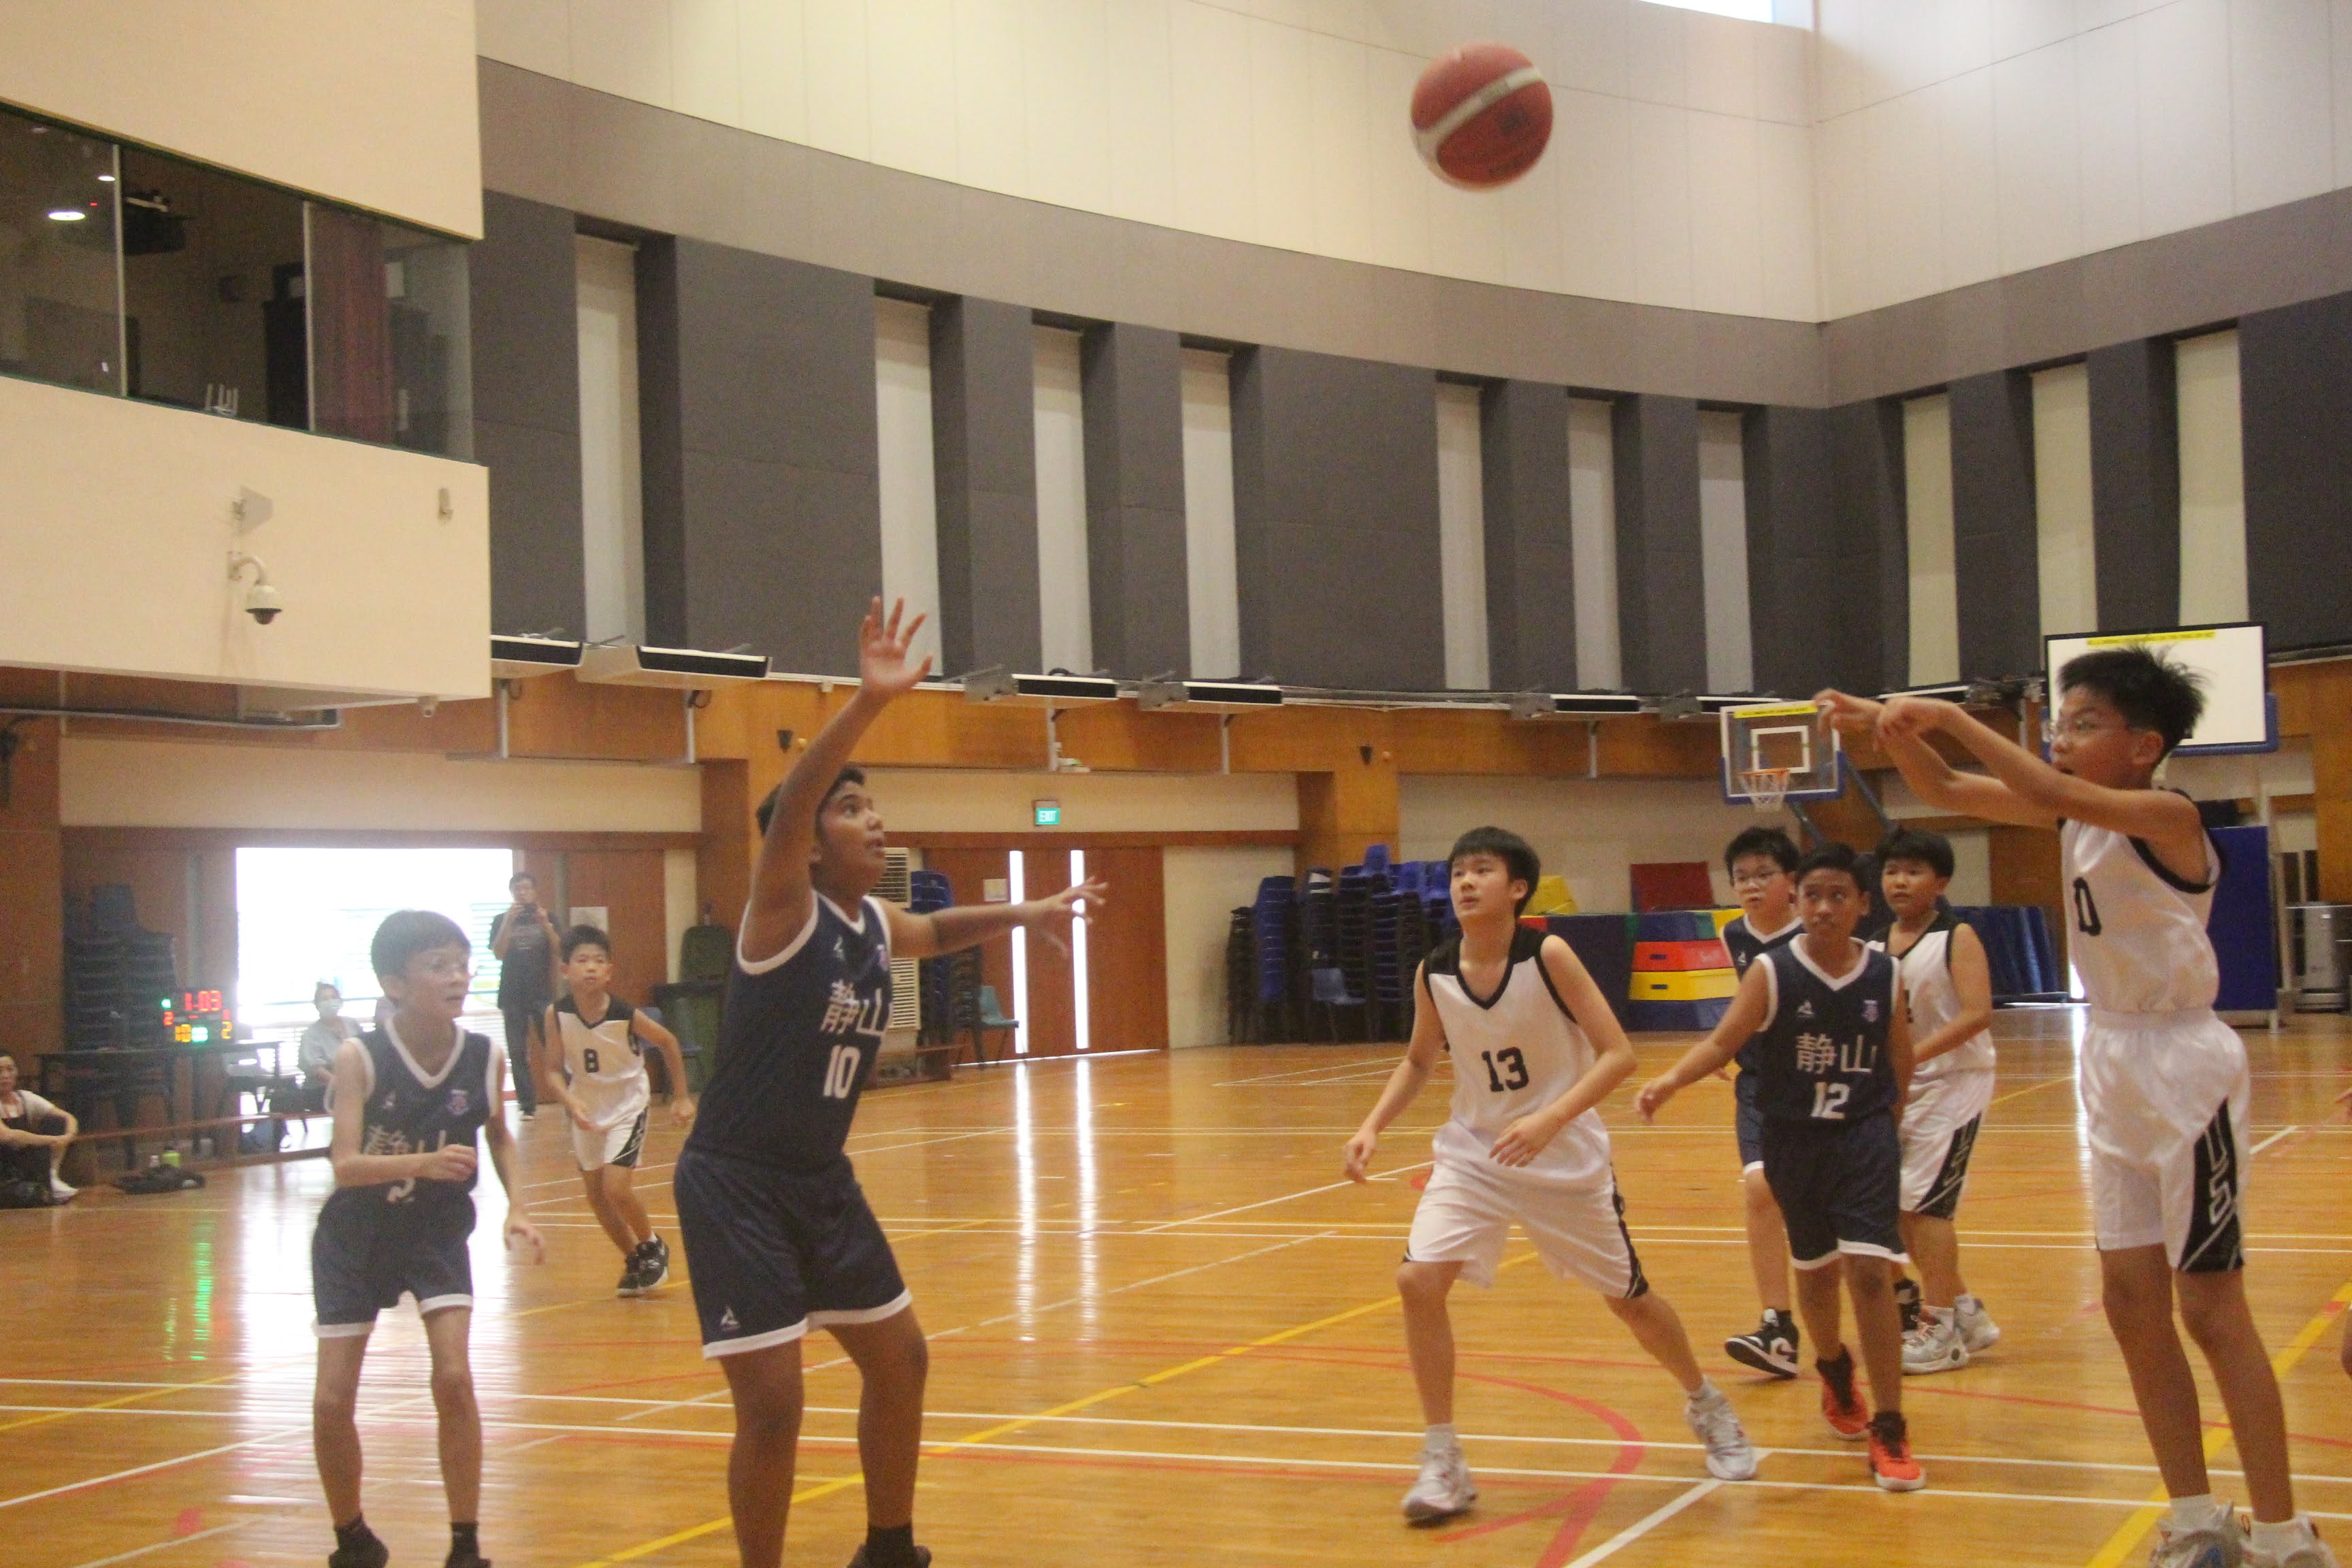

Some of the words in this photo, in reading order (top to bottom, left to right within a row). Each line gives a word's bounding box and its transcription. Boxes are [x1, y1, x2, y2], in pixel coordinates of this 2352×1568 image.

[221, 1021, 232, 1040] 2
[823, 1044, 862, 1099] 10
[1482, 1047, 1529, 1092] 13
[1796, 1032, 1878, 1075] 静山
[1810, 1081, 1850, 1120] 12
